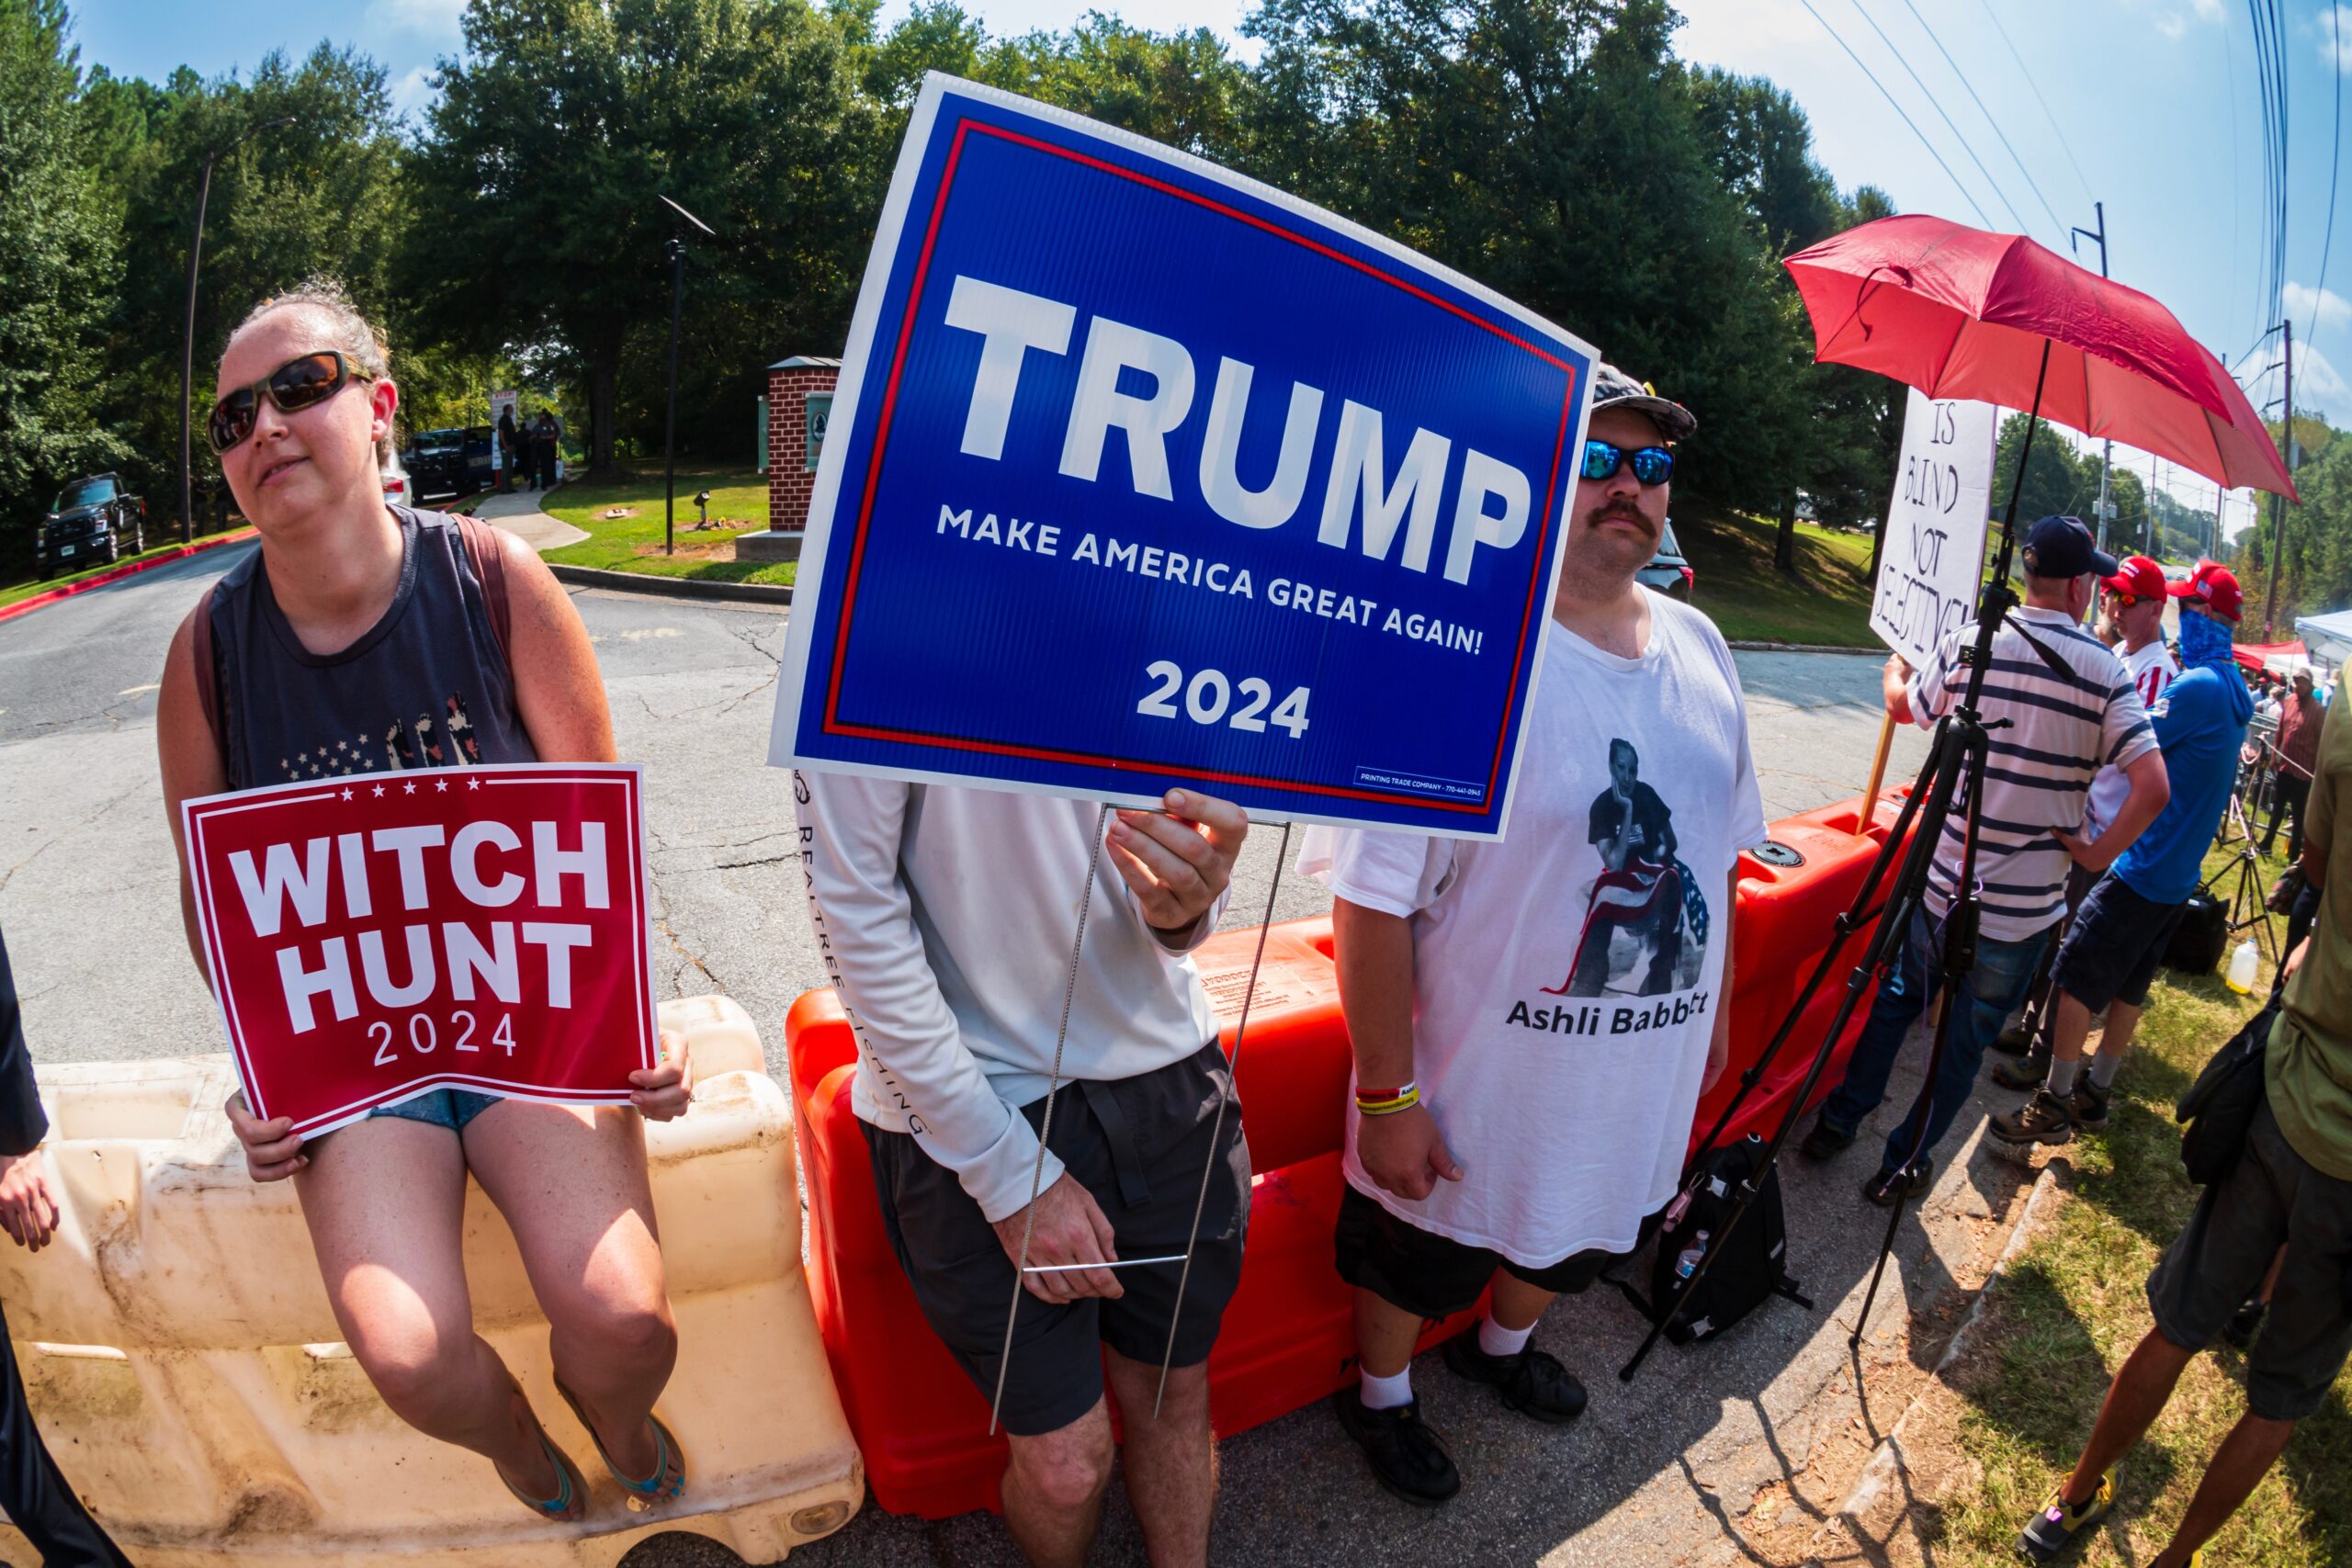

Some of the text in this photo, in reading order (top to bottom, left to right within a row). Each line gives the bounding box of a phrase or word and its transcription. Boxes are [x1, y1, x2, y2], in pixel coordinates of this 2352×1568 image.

[944, 274, 1532, 586] TRUMP
[1929, 401, 1956, 446] IS
[1903, 455, 1959, 514] BLIND
[936, 504, 1484, 655] MAKE AMERICA GREAT AGAIN!
[1908, 521, 1948, 578] NOT
[1136, 660, 1310, 739] 2024
[1361, 773, 1391, 784] PRINTING
[1391, 777, 1412, 786] TRADE
[1411, 780, 1442, 791] COMPANY
[228, 820, 610, 938] WITCH
[798, 826, 845, 989] REALTREE
[276, 921, 593, 1035] HUNT
[368, 1010, 517, 1066] 2024
[1506, 991, 1708, 1036] Ashli Babbtt
